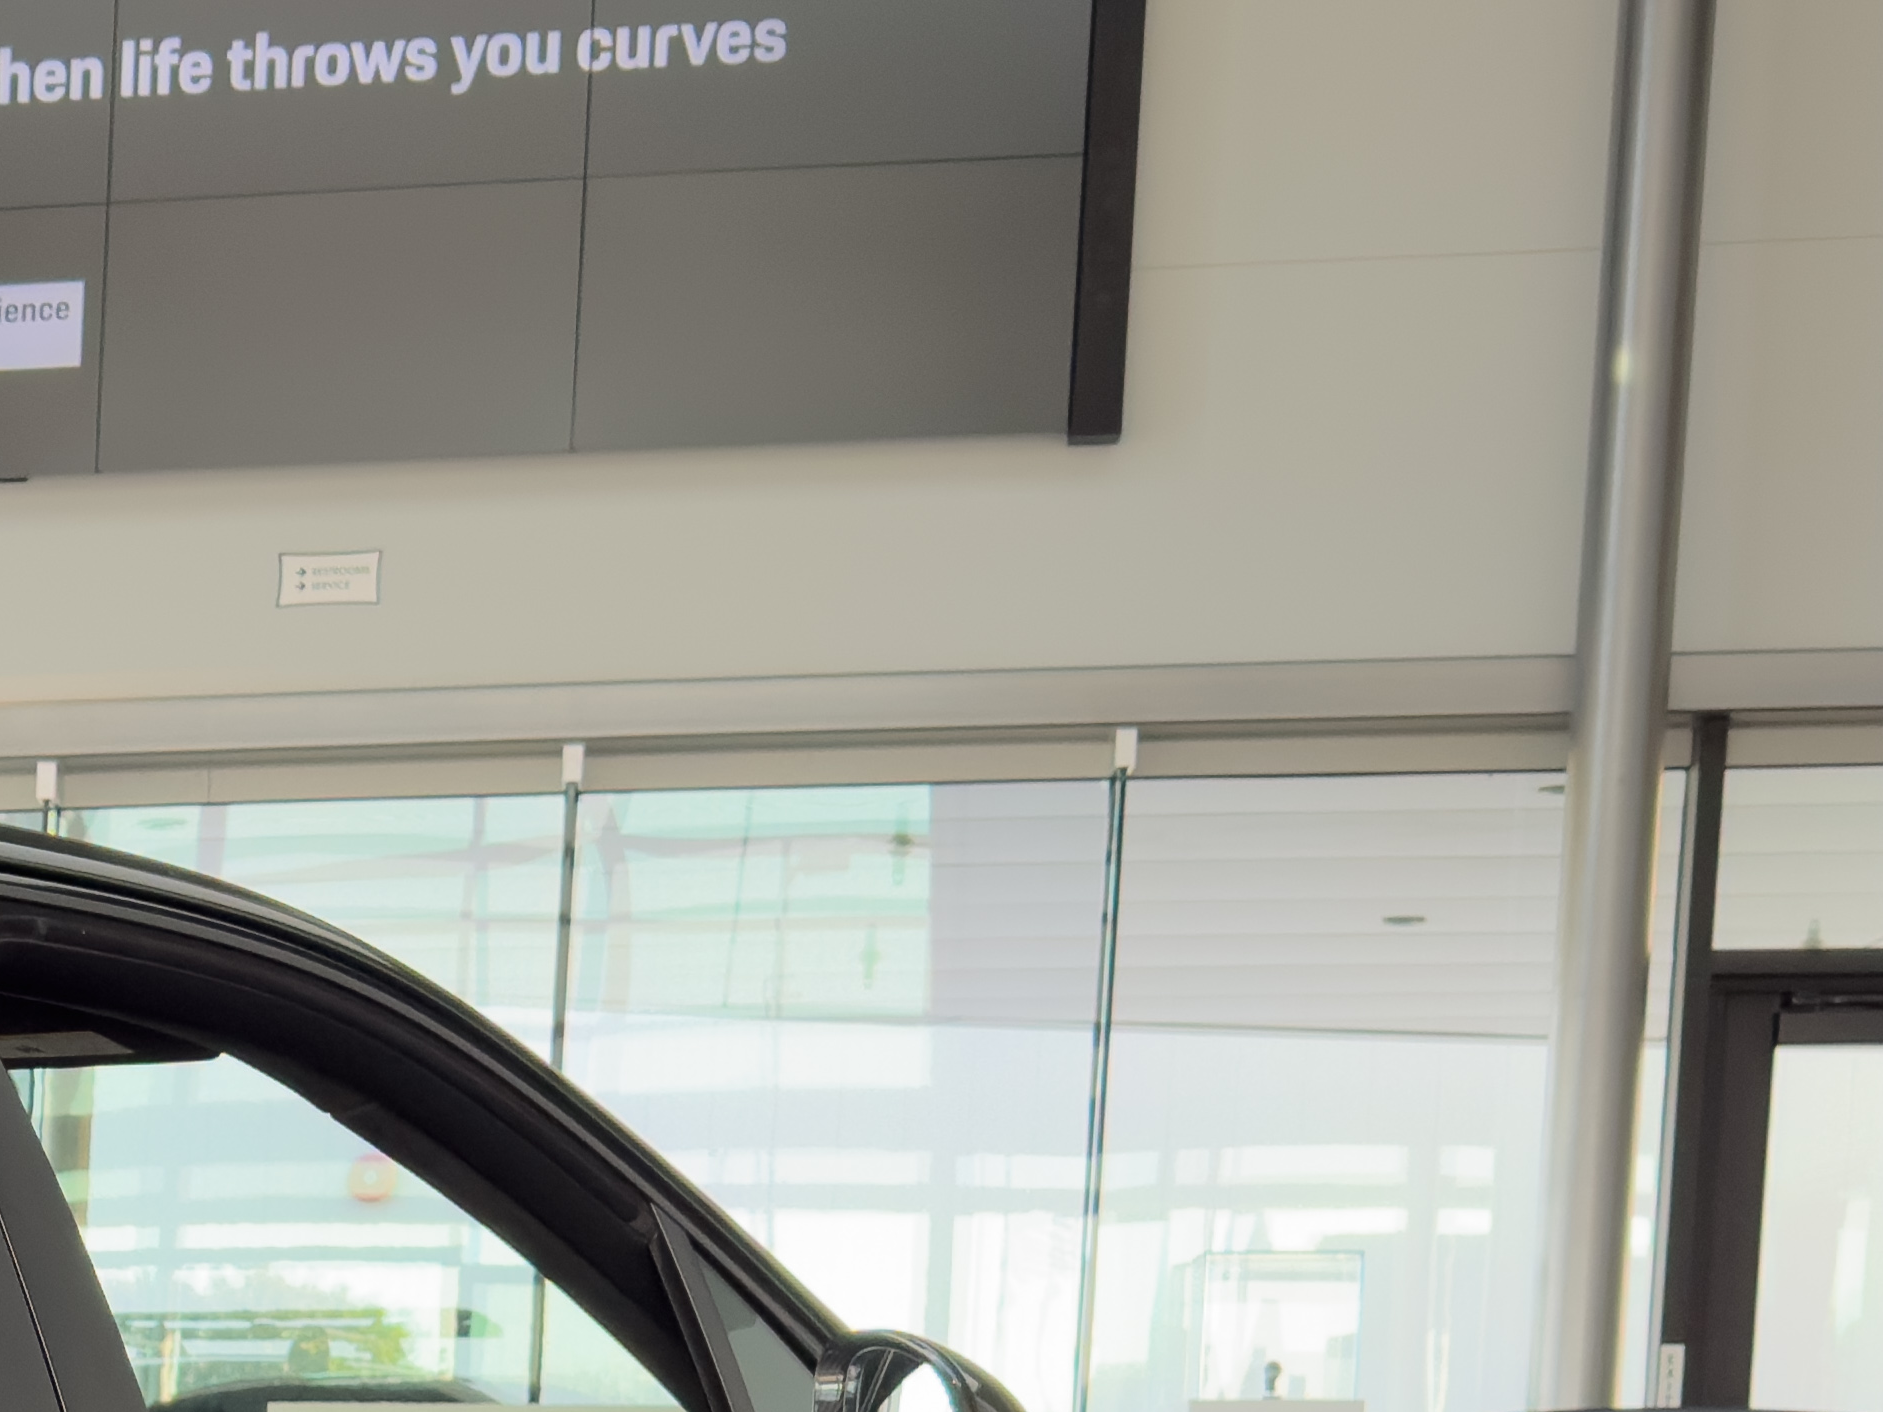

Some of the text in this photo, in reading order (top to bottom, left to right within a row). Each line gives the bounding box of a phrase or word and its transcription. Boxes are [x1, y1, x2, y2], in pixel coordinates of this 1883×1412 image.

[120, 36, 214, 98] life
[226, 30, 438, 92] throws
[450, 28, 562, 96] you
[576, 17, 788, 72] curves
